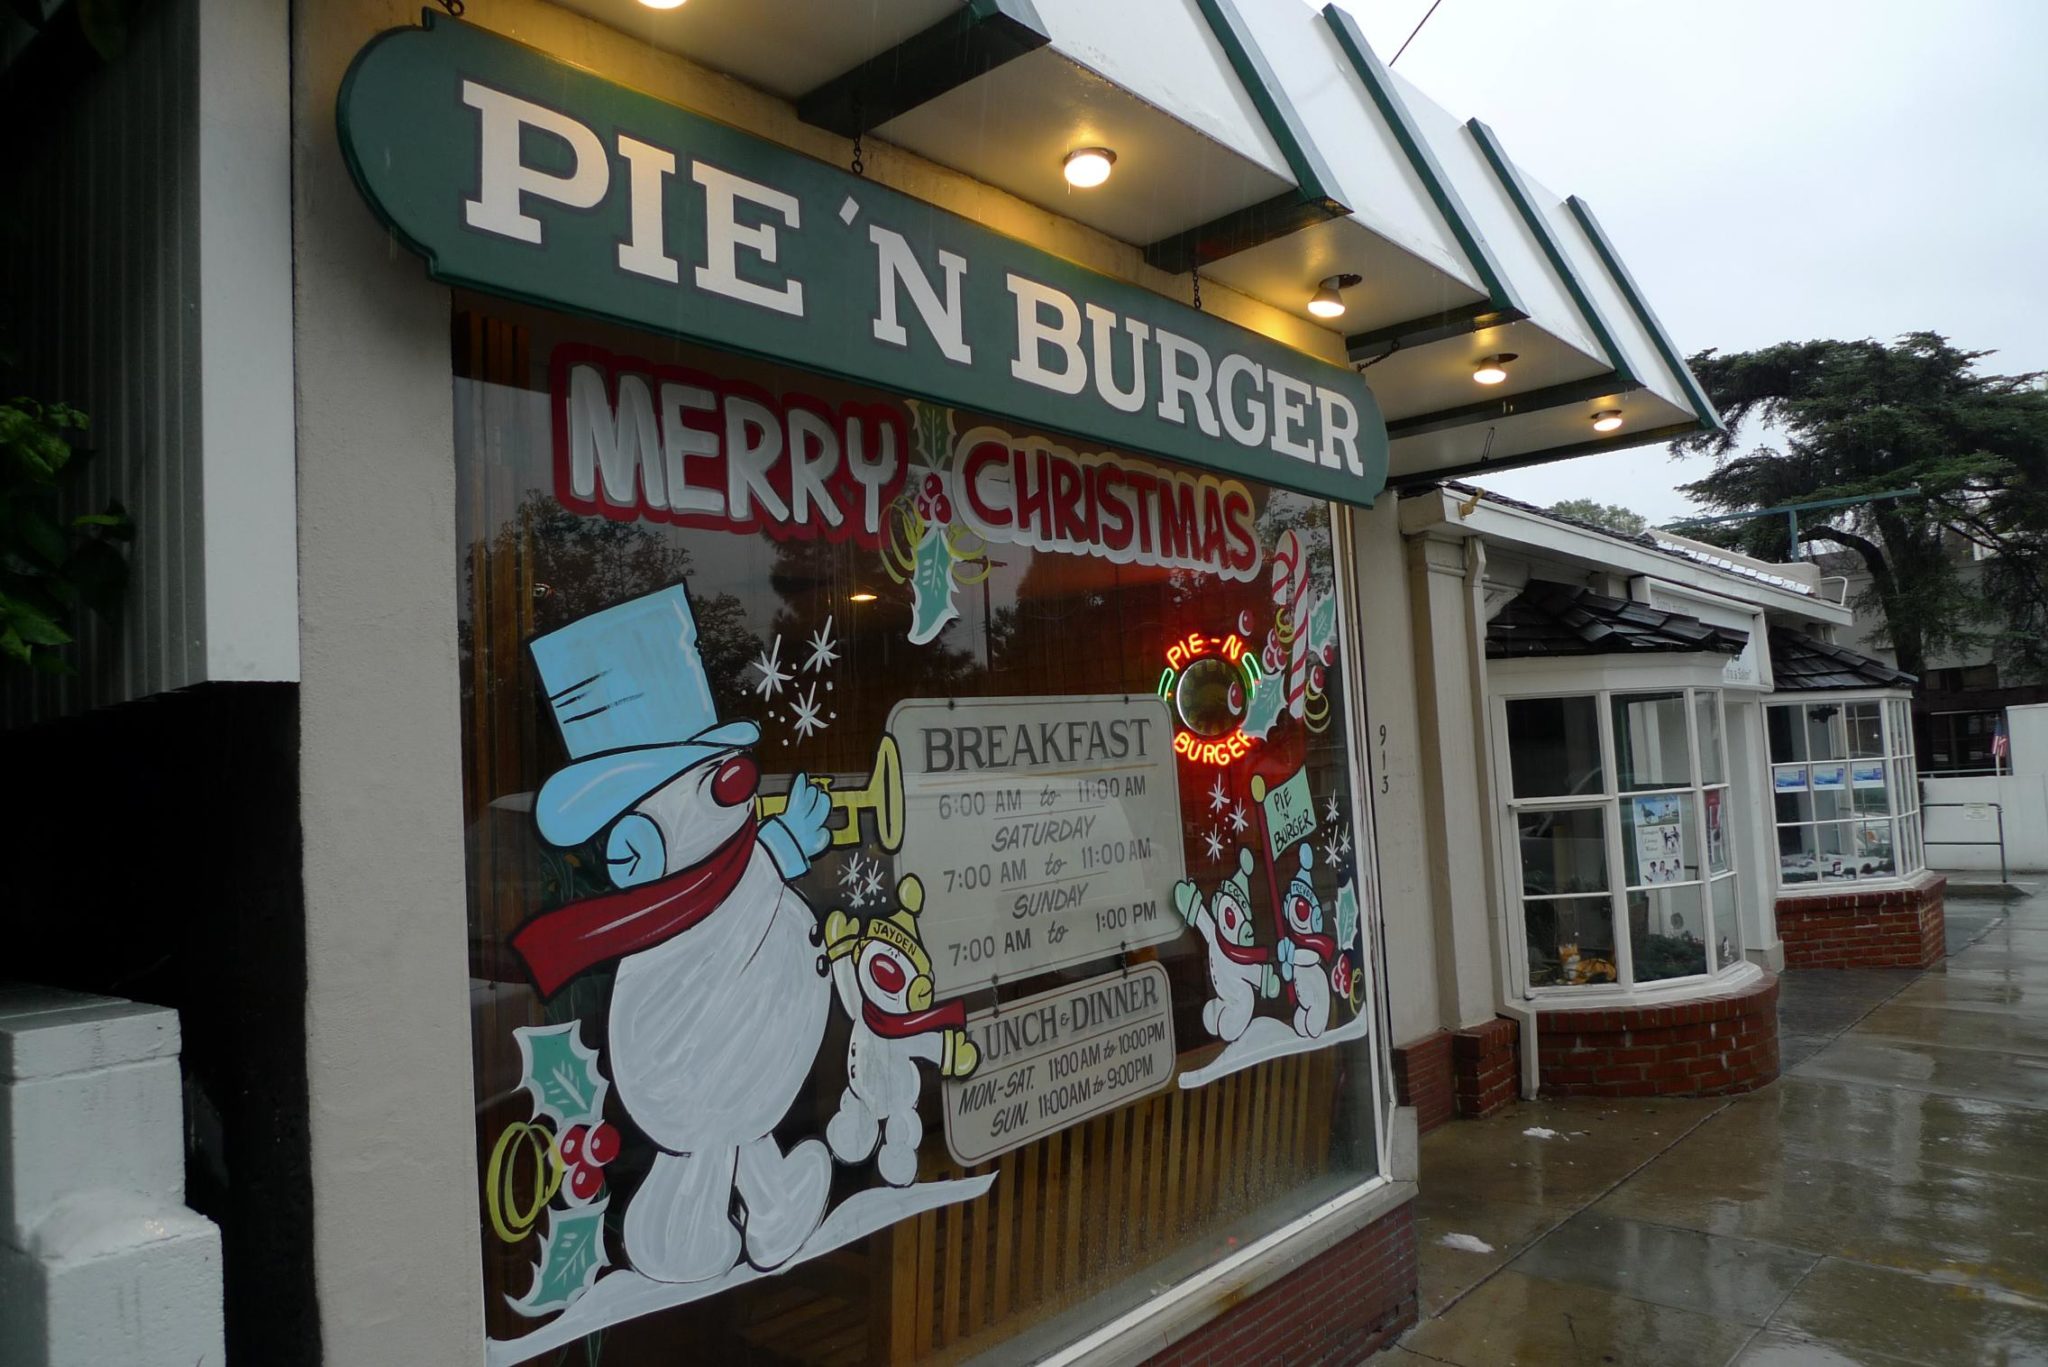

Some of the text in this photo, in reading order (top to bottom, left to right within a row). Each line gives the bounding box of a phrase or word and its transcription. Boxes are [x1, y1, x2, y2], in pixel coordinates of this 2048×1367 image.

[462, 79, 804, 317] PIE
[1006, 272, 1364, 478] BURGER
[562, 361, 1259, 573] MERRY CHRISTMAS
[920, 718, 1152, 774] BREAKFAST
[938, 791, 986, 820] 6:00
[995, 788, 1022, 813] AM
[1040, 785, 1062, 807] to
[1124, 775, 1147, 797] AM
[1273, 786, 1293, 812] PIE
[991, 814, 1097, 853] SATURDAY
[1273, 808, 1314, 852] BURGER
[943, 863, 992, 893] 7:00
[1000, 858, 1027, 884] AM
[1045, 853, 1068, 877] to
[1081, 841, 1126, 870] 11:00
[1012, 883, 1089, 920] SUNDAY
[873, 921, 917, 956] JAYDEN
[948, 901, 1158, 967] 7:00 AM to 1:00 PM
[1070, 975, 1159, 1032] DINNER
[1103, 1039, 1117, 1060] to
[990, 1100, 1029, 1137] SUN.
[1093, 1074, 1106, 1095] to
